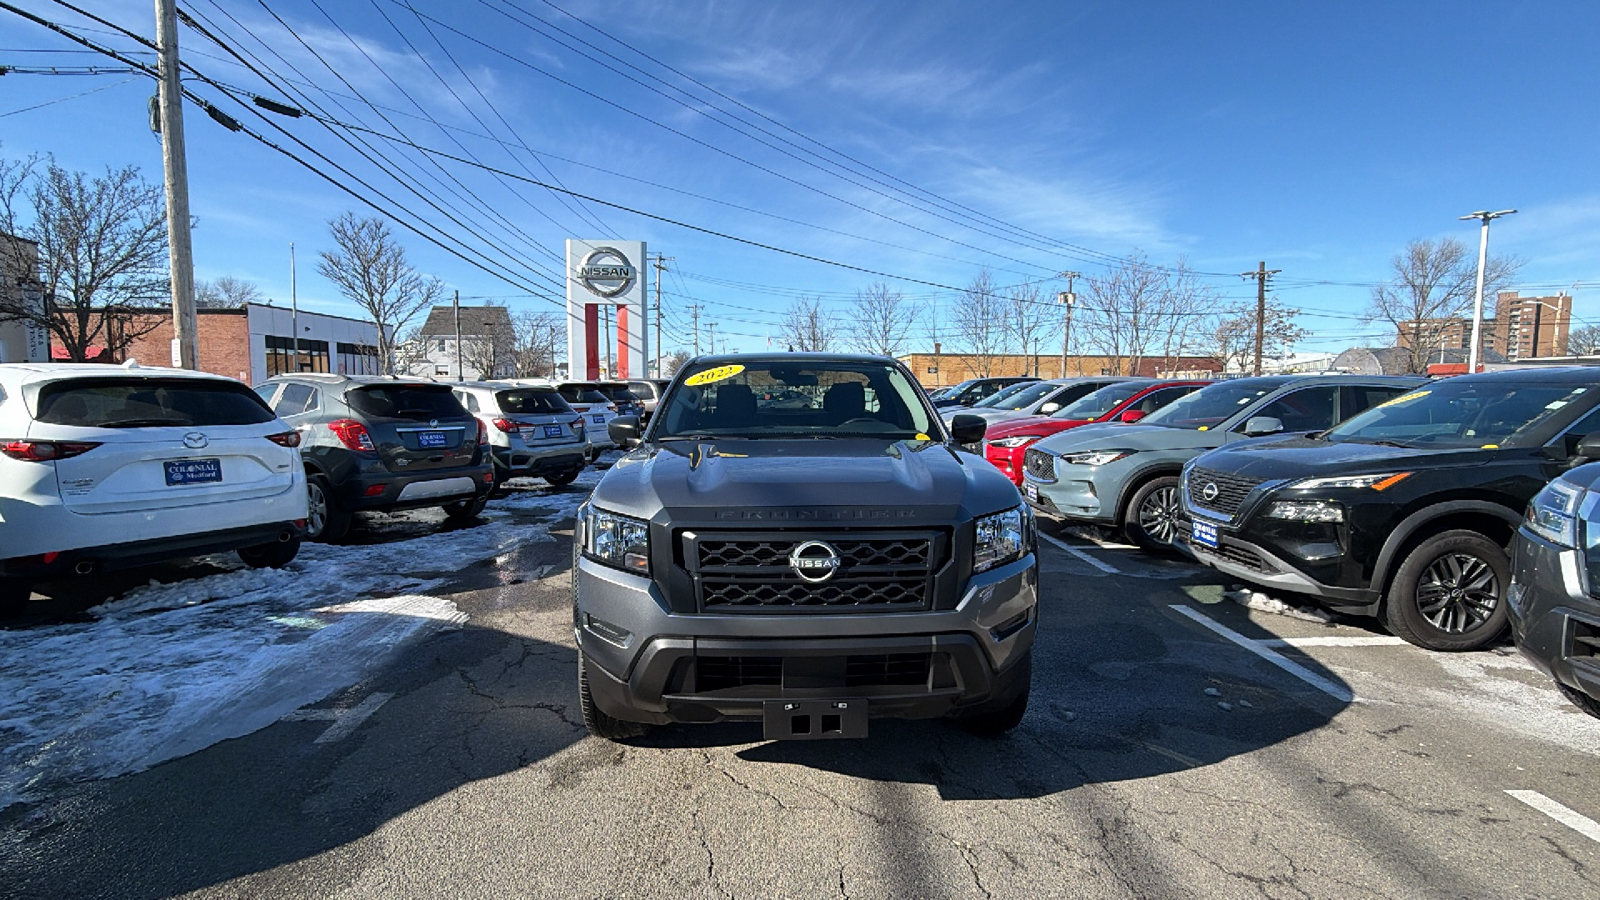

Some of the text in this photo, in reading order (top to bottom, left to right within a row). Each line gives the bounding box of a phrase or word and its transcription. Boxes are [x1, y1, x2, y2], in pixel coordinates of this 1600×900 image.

[581, 267, 629, 276] NISSAN
[697, 366, 733, 384] 2022
[169, 464, 218, 474] COLONIAL
[186, 471, 216, 479] Medford
[714, 509, 917, 520] FRONTIER
[791, 559, 840, 568] NISSAN
